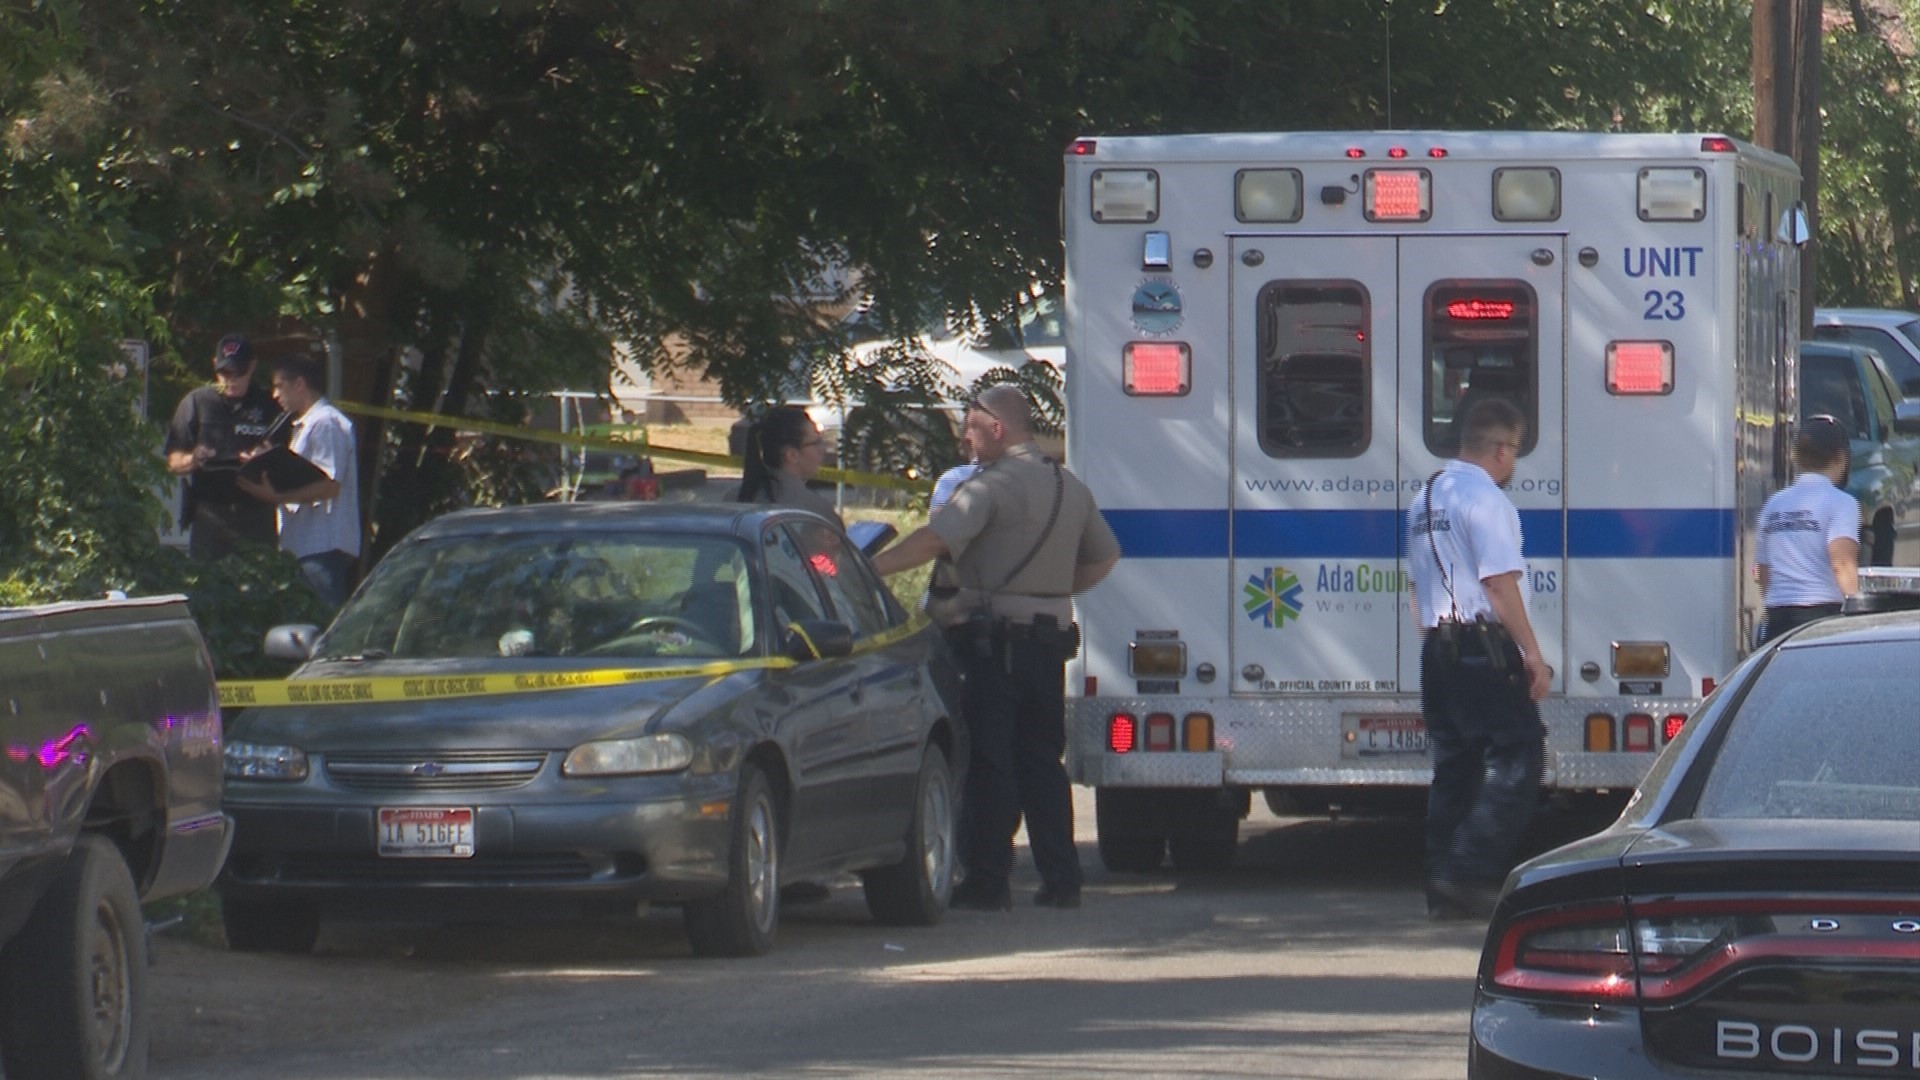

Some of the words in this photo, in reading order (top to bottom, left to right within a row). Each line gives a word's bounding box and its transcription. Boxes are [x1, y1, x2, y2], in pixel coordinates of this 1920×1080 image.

[1624, 246, 1703, 278] UNIT
[1643, 289, 1685, 321] 23
[234, 425, 267, 436] POLIC
[1259, 679, 1276, 690] FOR
[1279, 680, 1315, 690] OFFICIAL
[1318, 680, 1351, 690] COUNTY
[1355, 680, 1371, 690] USE
[1375, 680, 1396, 690] ONLY
[1368, 731, 1377, 748] C
[386, 823, 404, 844] 1A
[1716, 1020, 1920, 1069] BOIS
